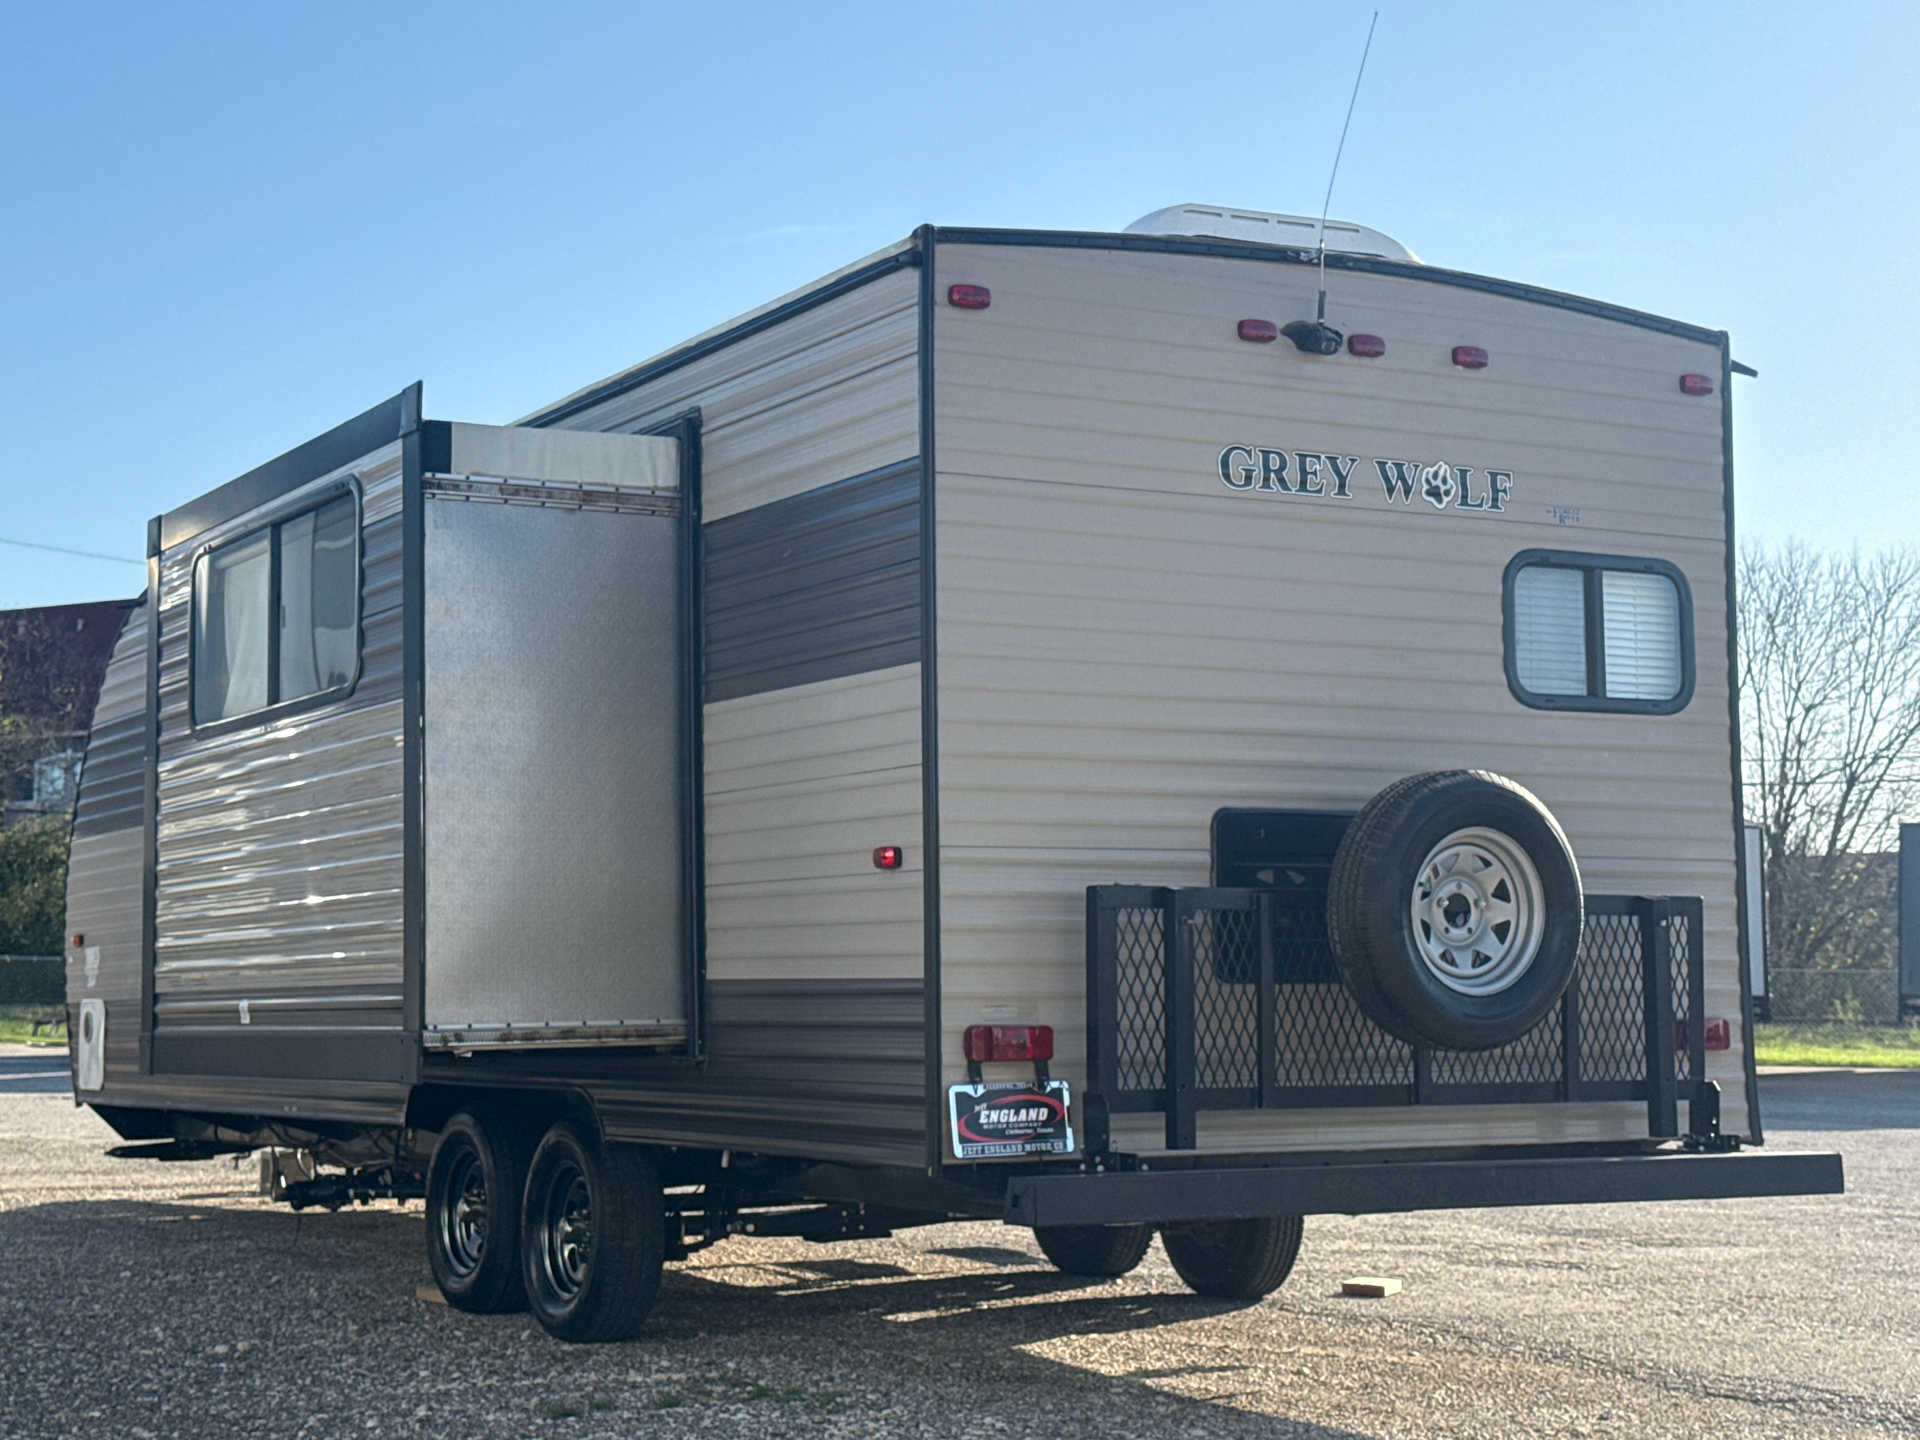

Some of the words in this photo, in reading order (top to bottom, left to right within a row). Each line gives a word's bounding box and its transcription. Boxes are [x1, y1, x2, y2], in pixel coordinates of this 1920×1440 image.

[1219, 445, 1359, 498] GREY
[979, 1108, 1049, 1123] ENGLAND
[963, 1147, 982, 1155] JEFF
[984, 1144, 1022, 1154] ENGLAND
[1024, 1142, 1052, 1152] MOTOR
